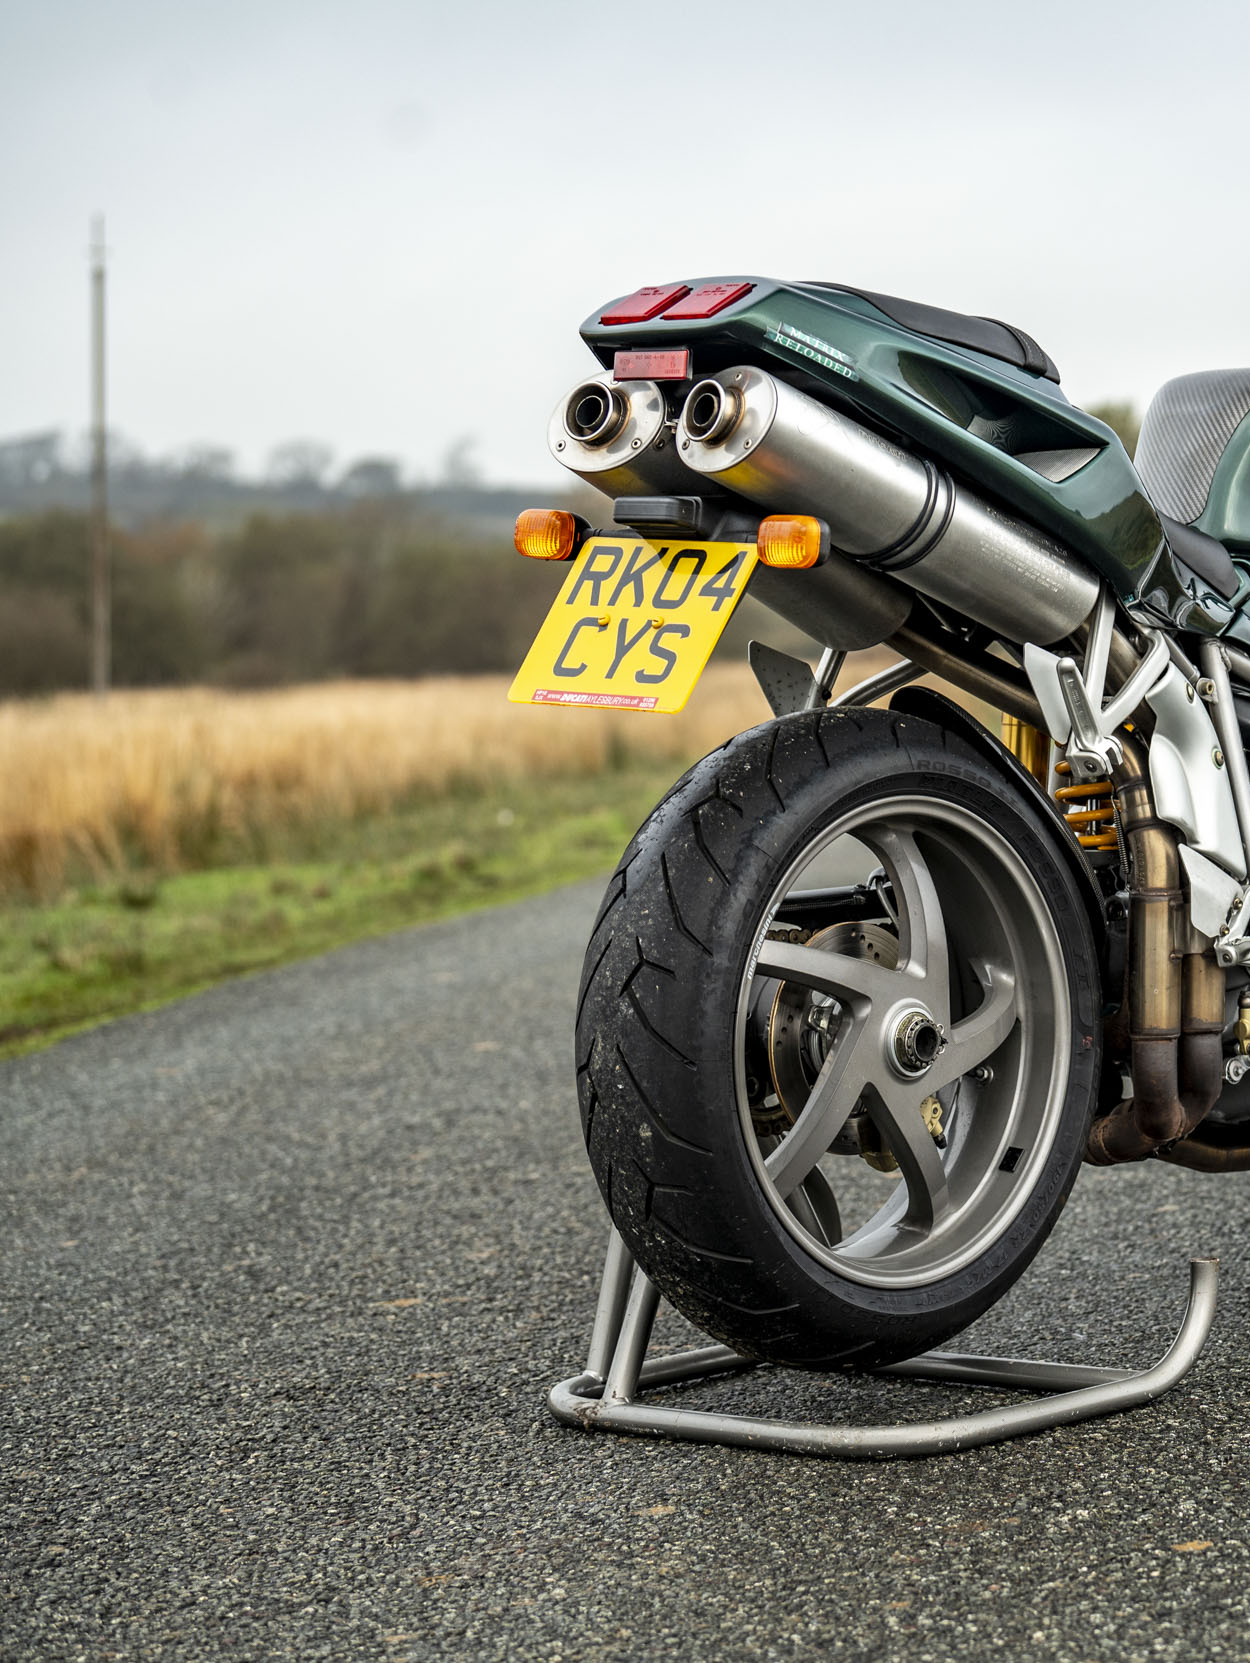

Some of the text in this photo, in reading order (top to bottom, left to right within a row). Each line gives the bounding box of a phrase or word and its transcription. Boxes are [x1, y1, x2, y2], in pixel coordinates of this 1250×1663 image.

[774, 332, 853, 378] RELOADED
[790, 326, 846, 362] MATRIX
[553, 617, 691, 684] CYS
[747, 913, 773, 980] marchesini
